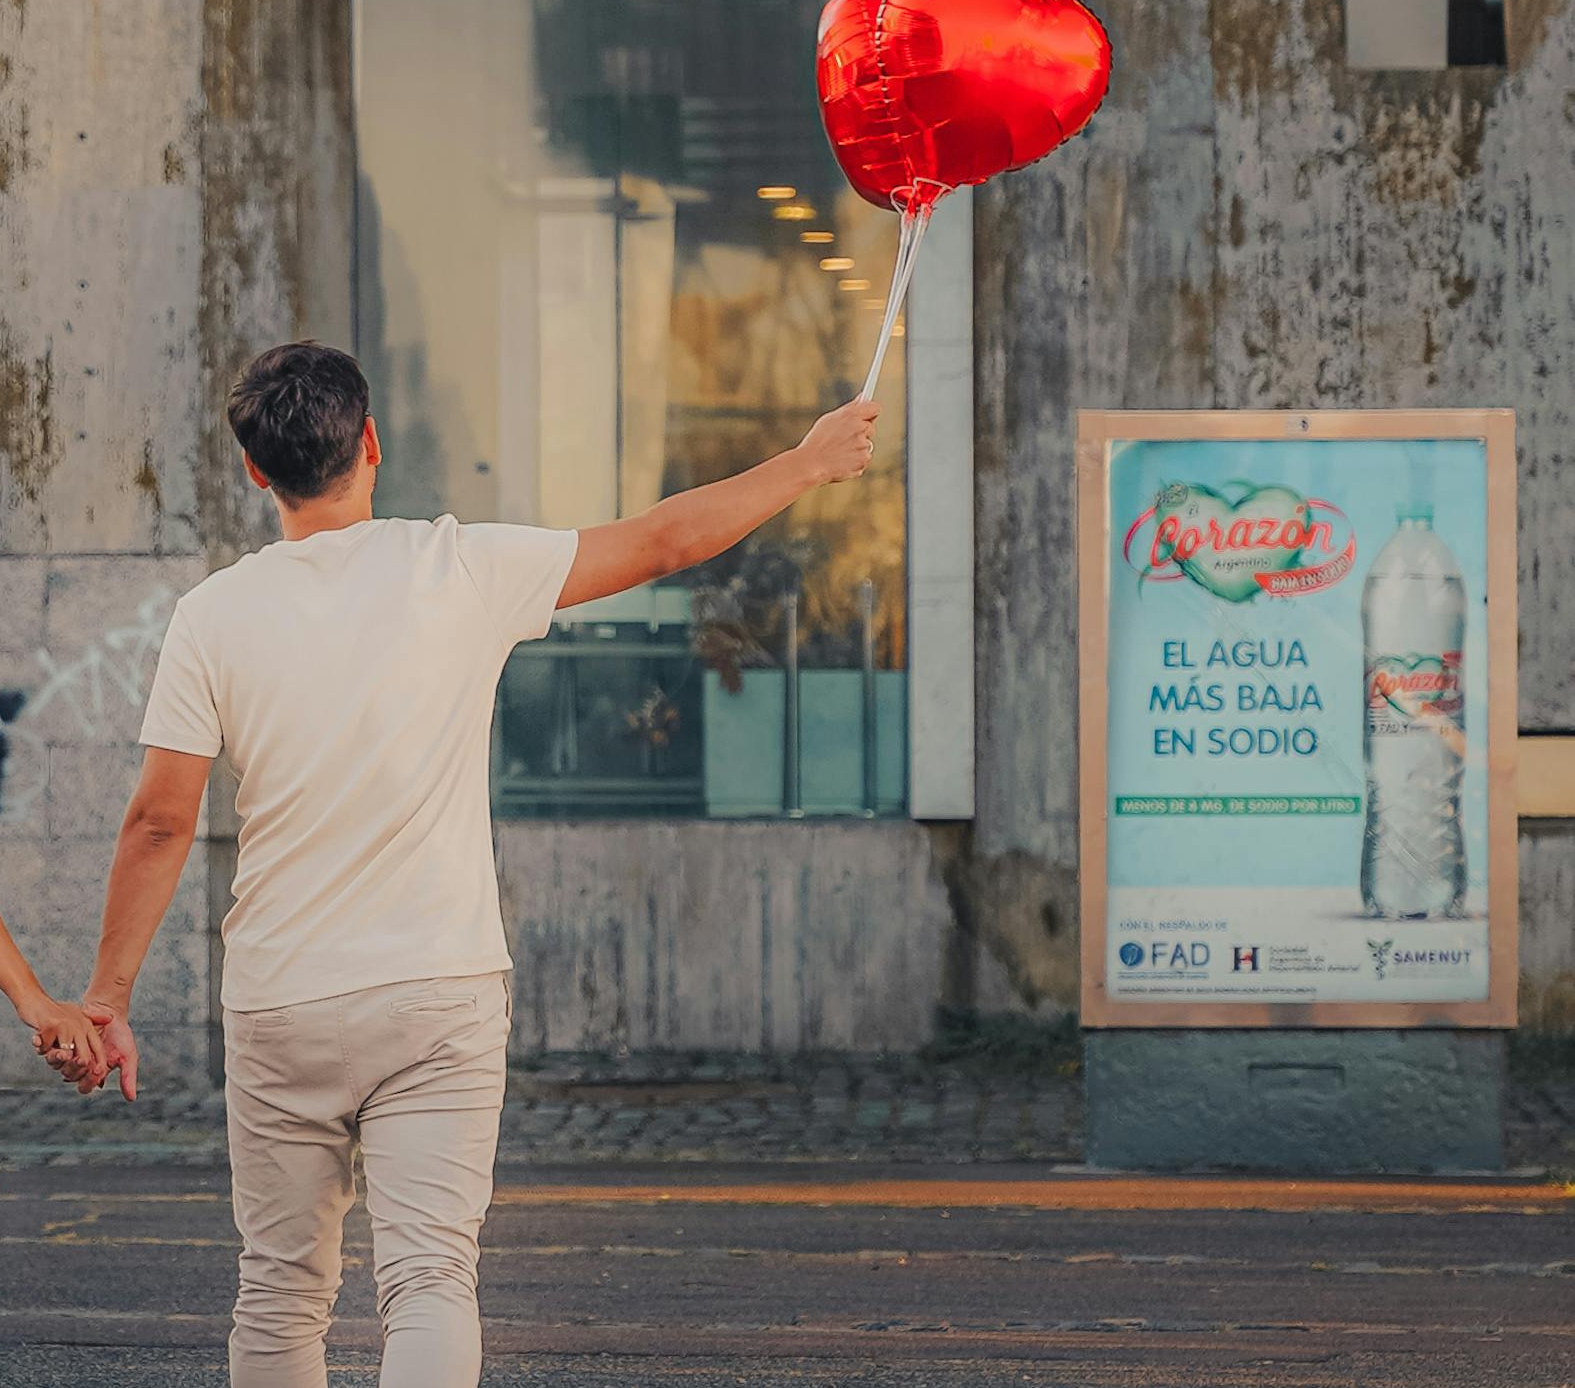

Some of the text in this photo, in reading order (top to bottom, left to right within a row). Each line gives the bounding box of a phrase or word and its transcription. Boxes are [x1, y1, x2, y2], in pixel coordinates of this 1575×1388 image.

[1150, 505, 1335, 570] Corazón
[1163, 640, 1308, 667] EL AGUA
[1149, 674, 1323, 712] MÁS BAJA
[1154, 727, 1319, 755] EN SODIO
[1151, 942, 1210, 967] FAD
[1393, 949, 1471, 965] SAMENUT
